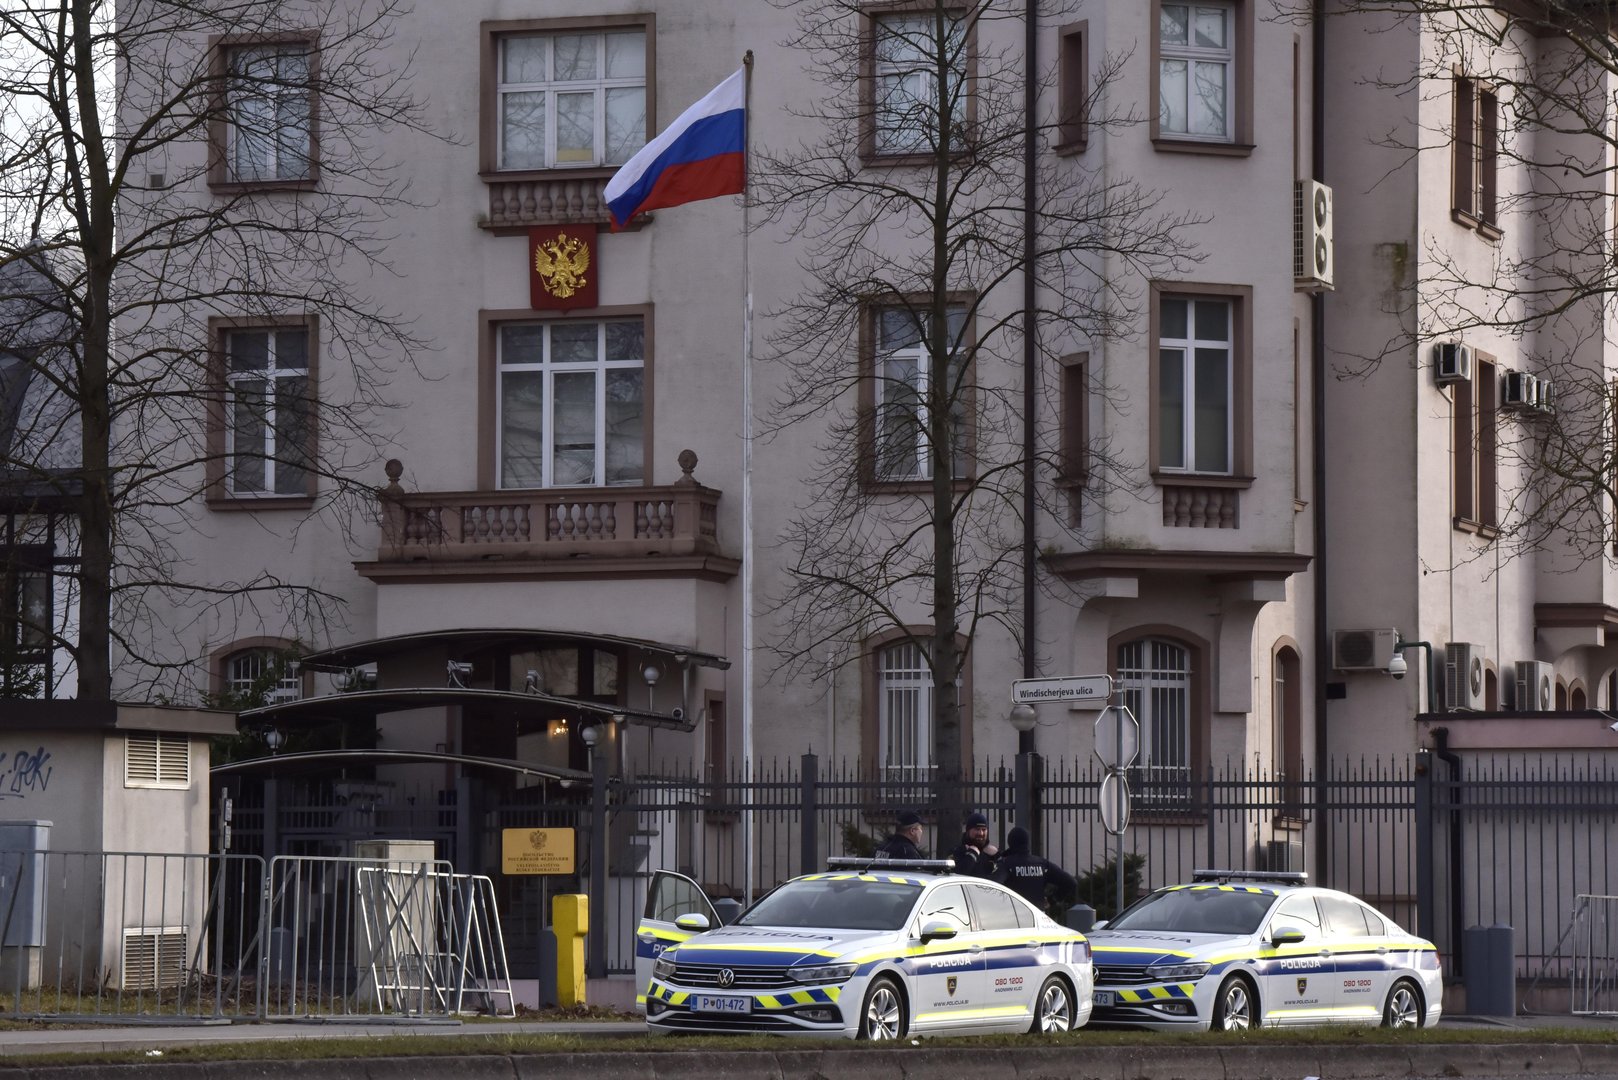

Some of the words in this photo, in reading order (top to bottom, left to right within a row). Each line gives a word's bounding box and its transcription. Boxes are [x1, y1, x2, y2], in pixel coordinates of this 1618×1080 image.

[1019, 687, 1074, 698] Windischerjeva
[1076, 686, 1093, 695] ulica
[1015, 866, 1043, 877] POLICIJA
[707, 931, 834, 941] POLICIJA
[930, 957, 972, 968] POLICIJA
[1280, 959, 1321, 970] POLICIJA
[995, 978, 1007, 986] 080
[703, 999, 710, 1009] P
[715, 999, 744, 1011] 01-472
